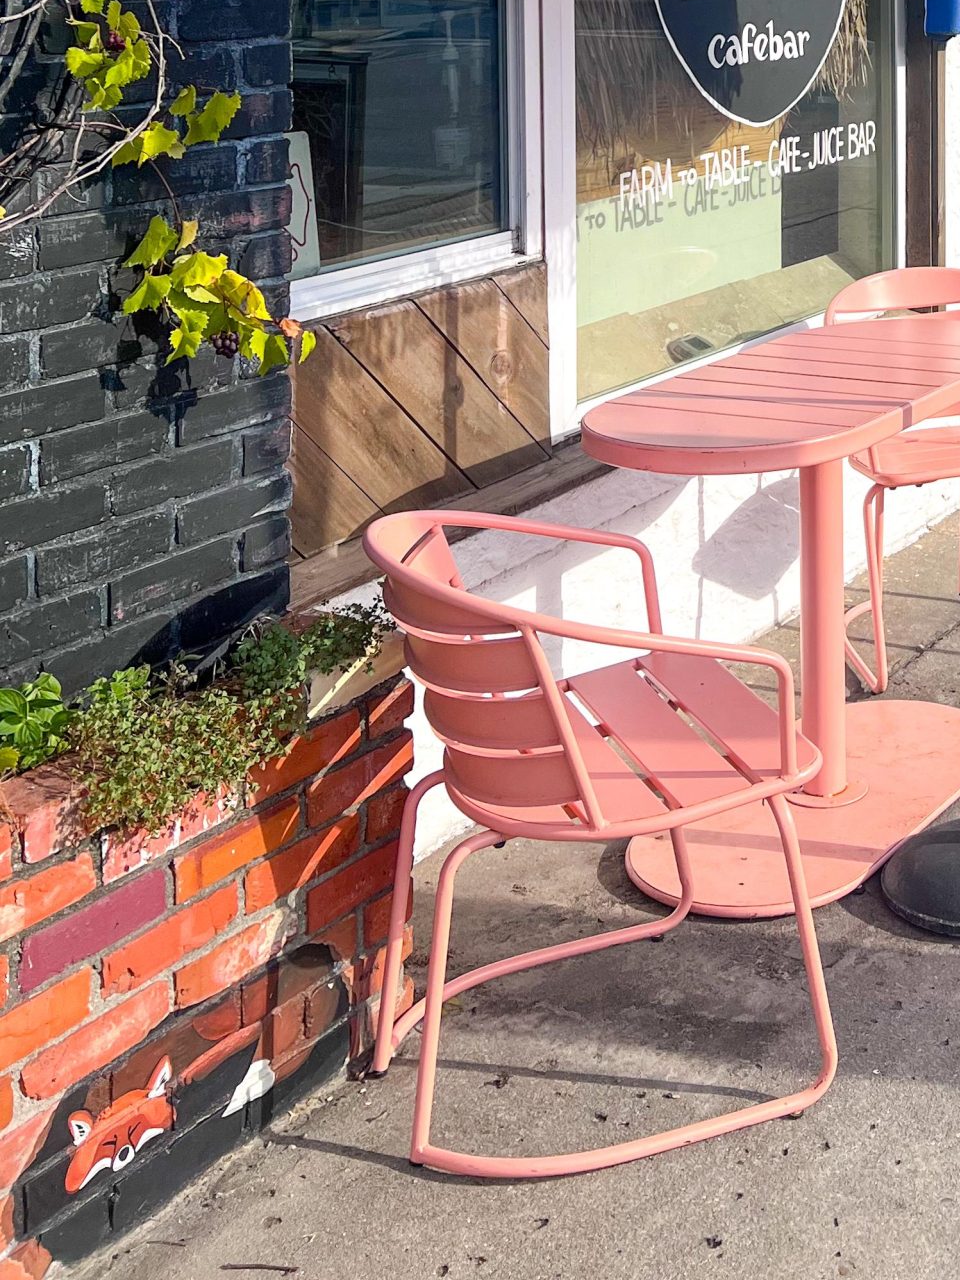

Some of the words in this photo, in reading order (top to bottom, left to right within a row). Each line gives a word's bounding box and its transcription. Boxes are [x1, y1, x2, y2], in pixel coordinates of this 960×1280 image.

[707, 19, 811, 69] cafebar
[619, 157, 674, 212] FARM
[700, 144, 751, 192] TABLE
[847, 120, 877, 161] BAR
